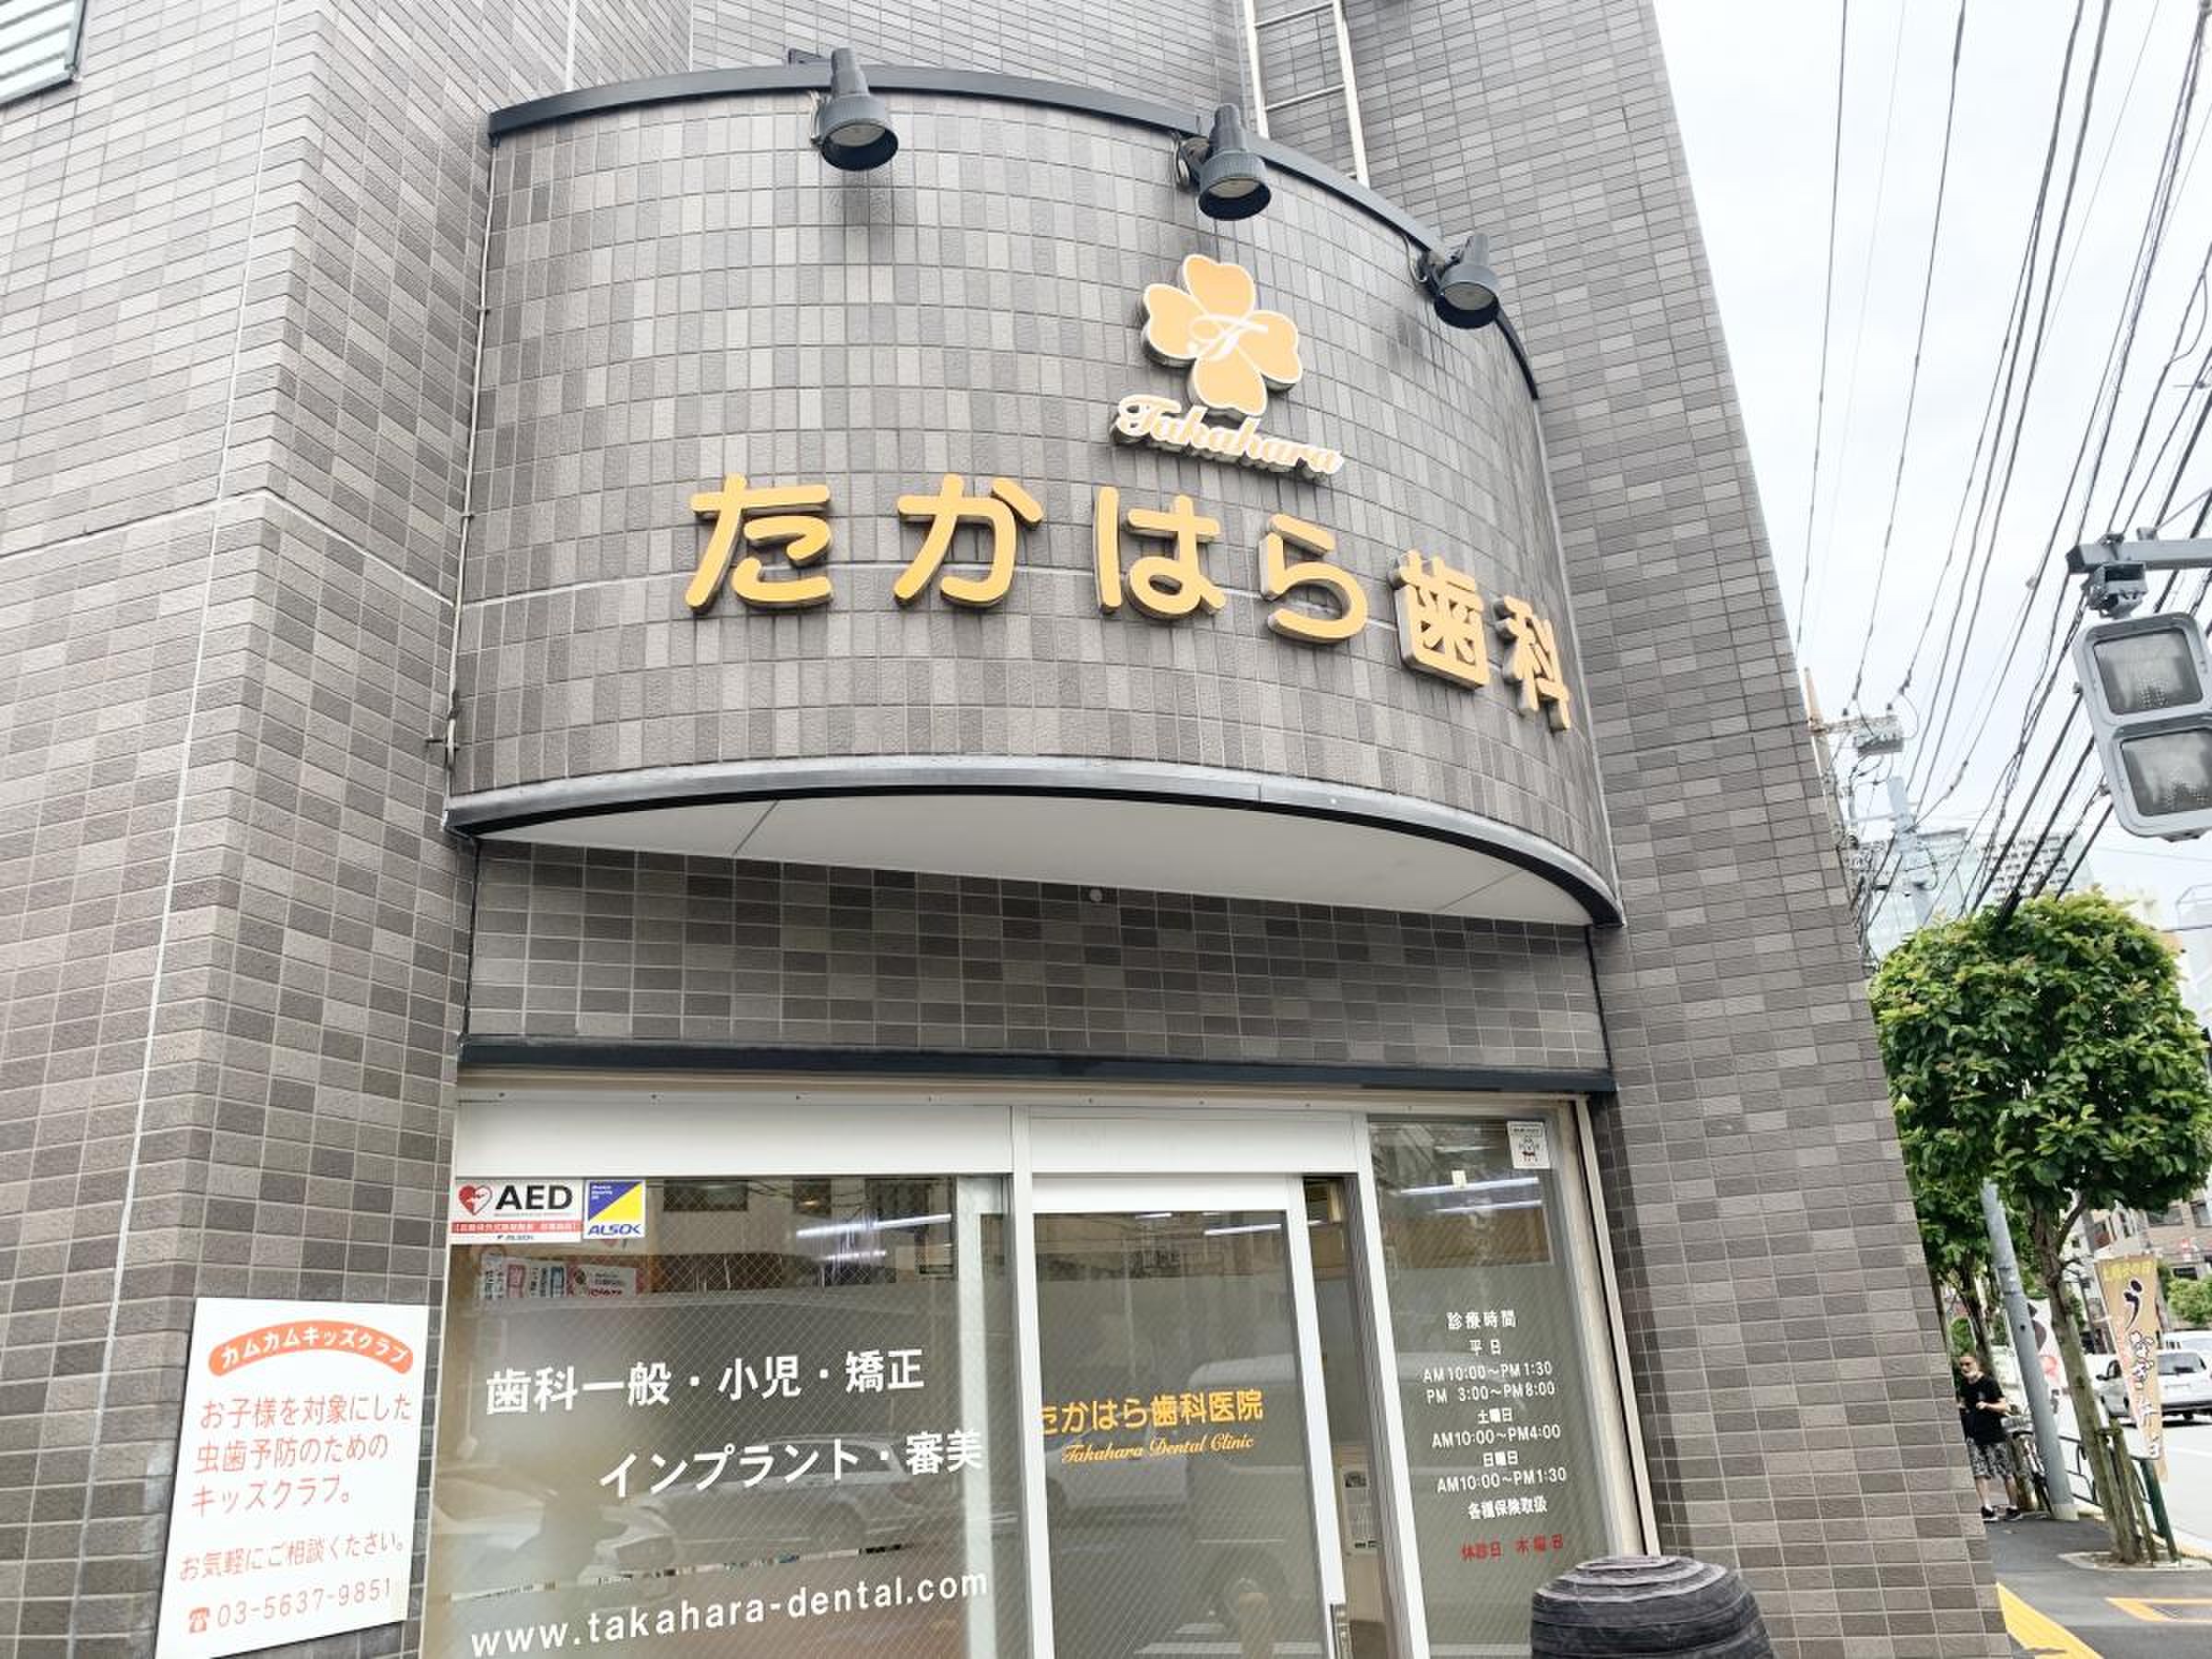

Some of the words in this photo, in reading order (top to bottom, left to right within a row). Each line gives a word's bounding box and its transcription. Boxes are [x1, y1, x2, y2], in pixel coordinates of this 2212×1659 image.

[1111, 394, 1345, 477] Takahara
[685, 473, 1571, 731] たかはら歯科
[495, 1184, 573, 1210] AED
[588, 1223, 642, 1236] ALSOK
[1446, 1310, 1516, 1330] 診療時間
[221, 1326, 408, 1370] カムカムキッズクラブ
[1469, 1339, 1500, 1357] 平日
[486, 1348, 925, 1415] 歯科一般・小児・矯正
[199, 1394, 413, 1430] お子様を対象にした
[1477, 1407, 1513, 1424] 土曜日
[194, 1434, 389, 1474] 虫歯予防のための
[599, 1429, 985, 1499] インプラント・審美
[1062, 1441, 1144, 1463] Takahara
[1150, 1433, 1208, 1457] Dental
[1209, 1432, 1254, 1452] Clinic
[1483, 1450, 1519, 1467] 日曜日
[180, 1531, 404, 1581] お気軽にご相談ください。
[218, 1577, 391, 1627] 03-5637-9851
[471, 1570, 988, 1658] www.takahara-dental.com
